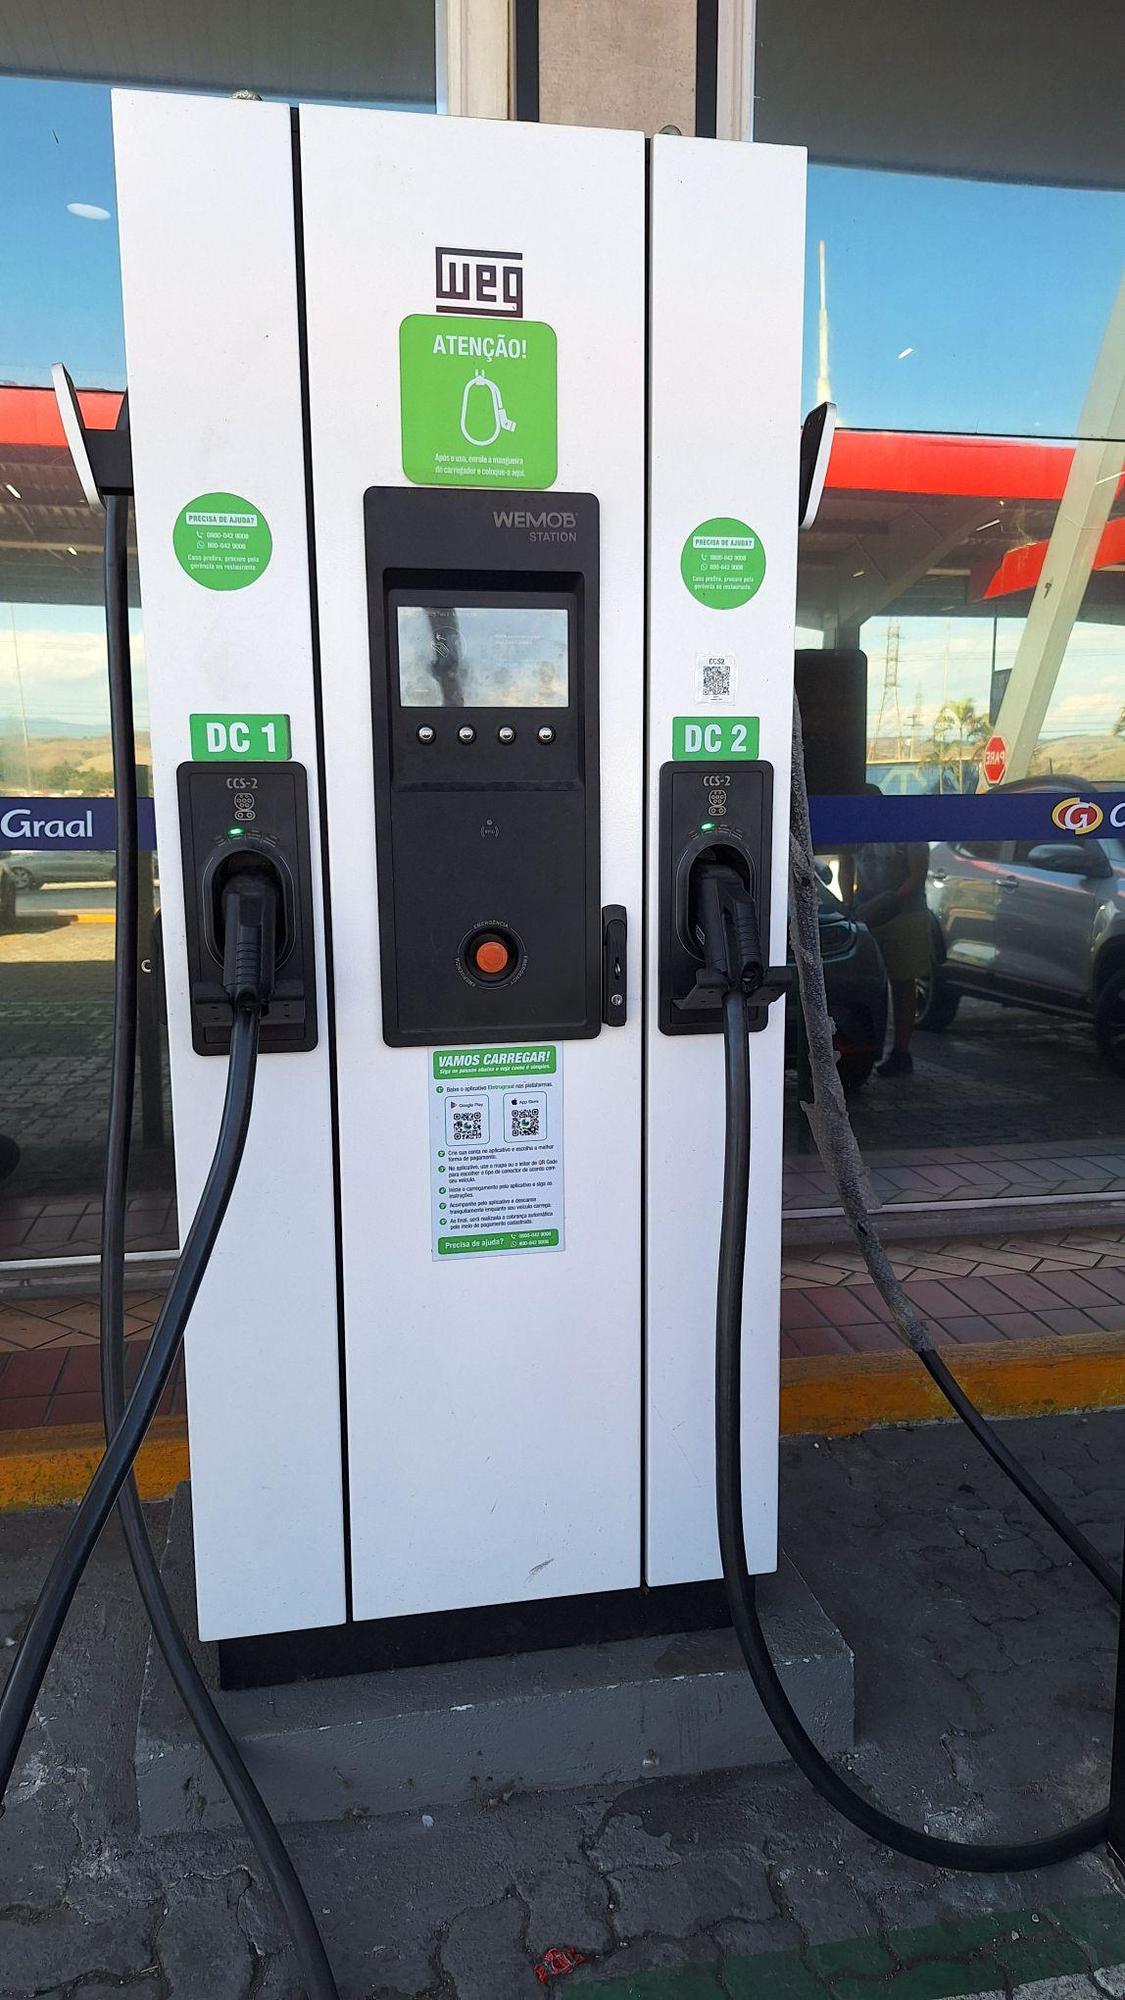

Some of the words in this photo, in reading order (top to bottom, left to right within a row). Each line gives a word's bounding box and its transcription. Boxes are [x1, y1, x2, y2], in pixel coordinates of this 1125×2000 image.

[433, 335, 527, 363] ATENÇÃO!
[188, 515, 217, 523] PRECISA
[229, 516, 255, 524] AJUDA?
[493, 511, 577, 528] WEMOB
[529, 532, 576, 542] STATION
[708, 657, 725, 665] CCS2
[206, 722, 250, 753] DC
[261, 722, 276, 753] 1
[685, 724, 722, 753] DC
[731, 724, 747, 753] 2
[226, 778, 258, 789] CCS-2
[703, 775, 731, 786] CCS-2
[0, 809, 93, 838] Graal
[438, 1055, 480, 1067] VAMOS
[483, 1051, 551, 1065] CARREGAR!
[445, 1240, 470, 1249] Precisa
[472, 1239, 480, 1247] de
[481, 1238, 505, 1248] ajuda?
